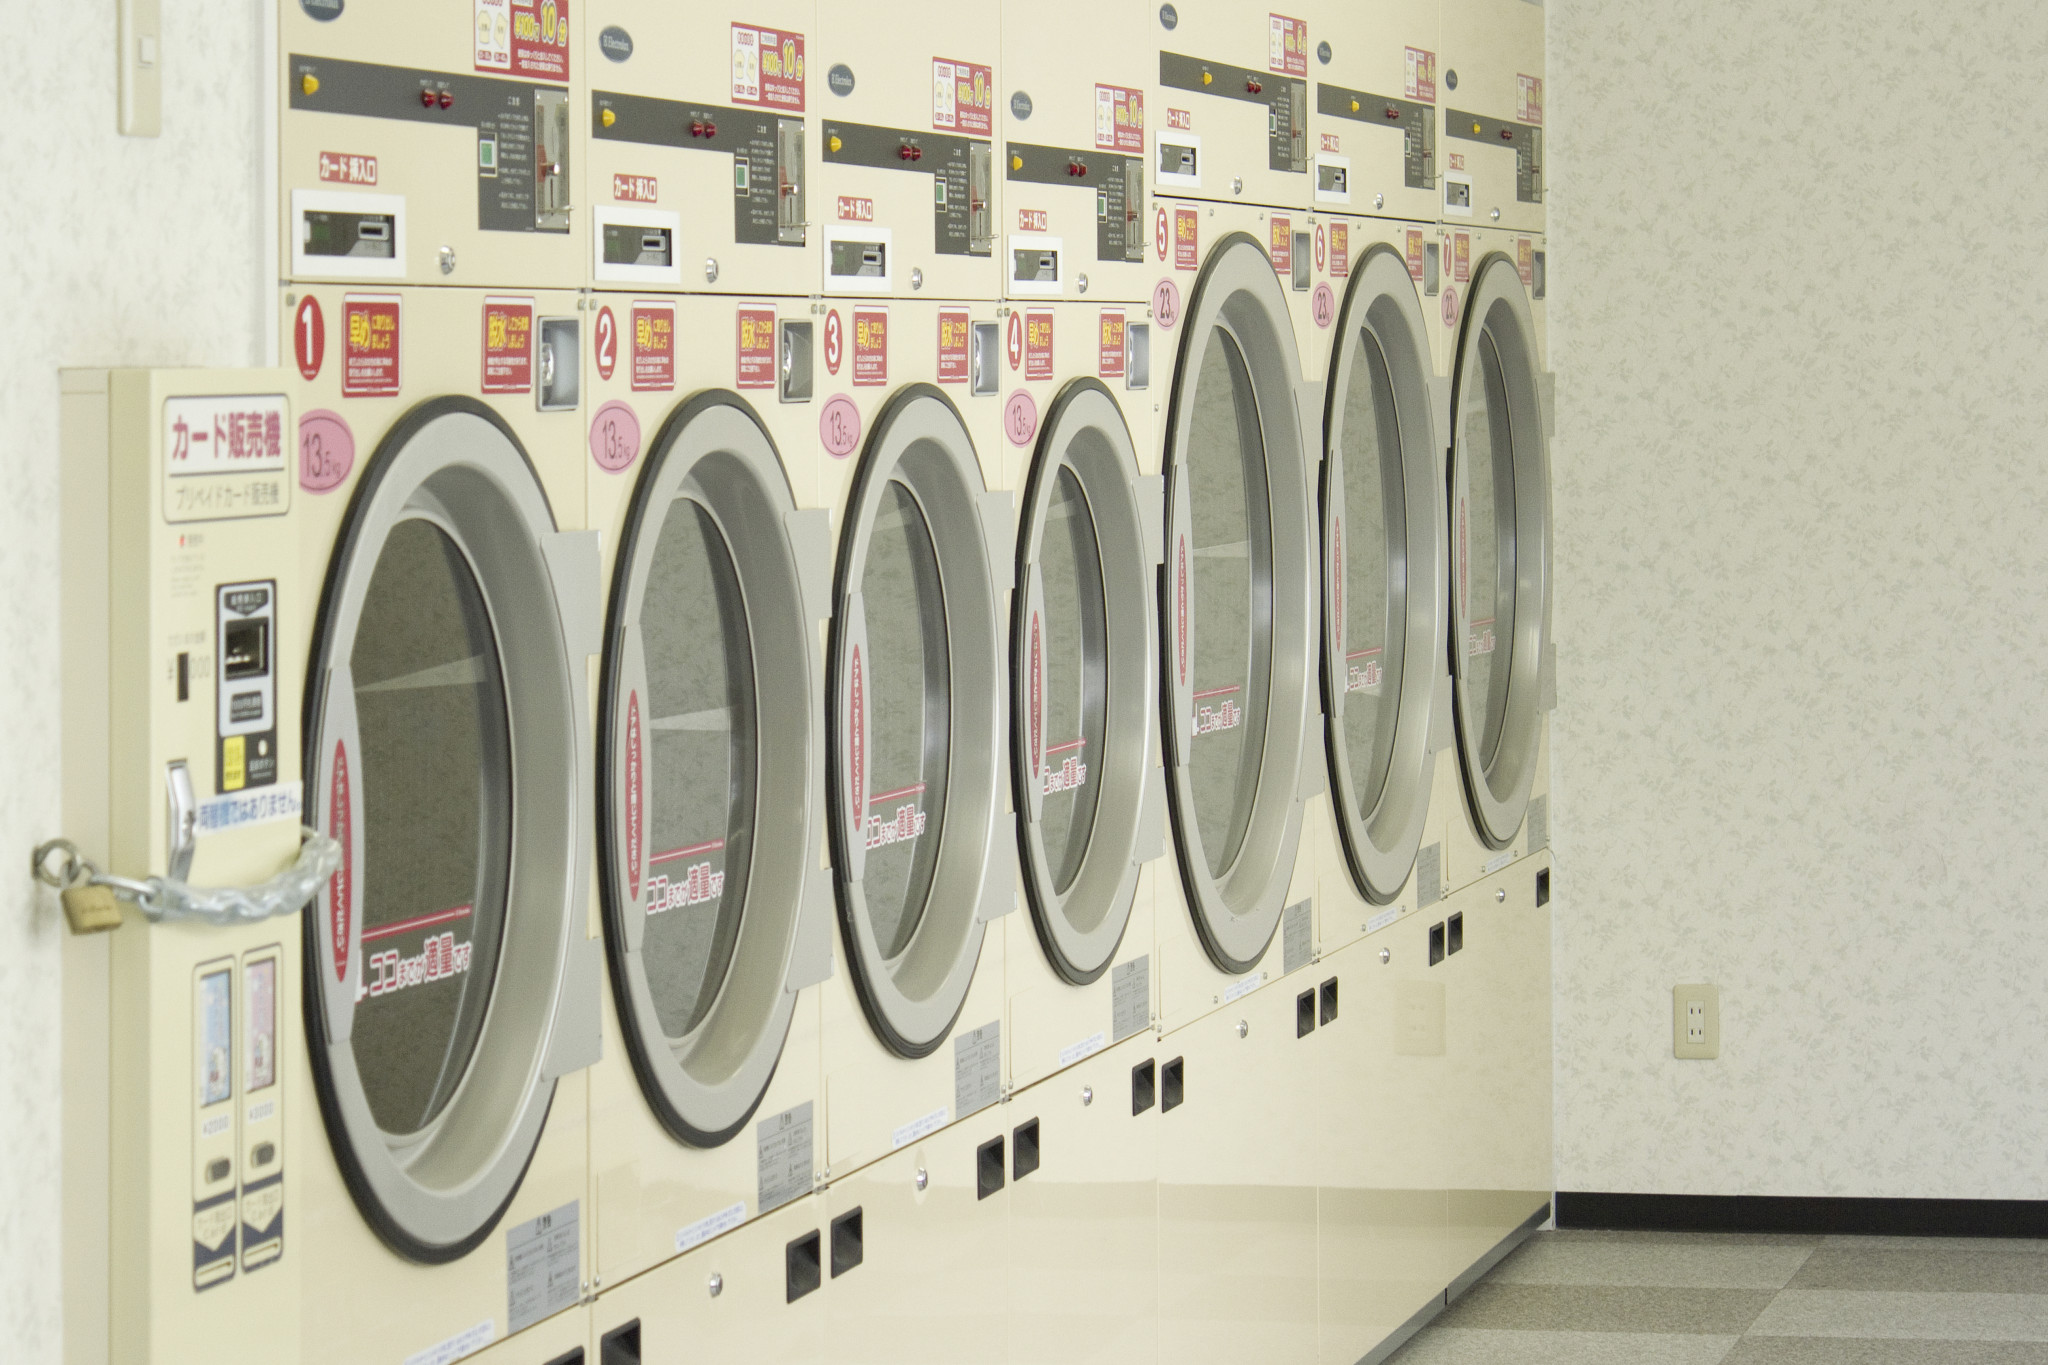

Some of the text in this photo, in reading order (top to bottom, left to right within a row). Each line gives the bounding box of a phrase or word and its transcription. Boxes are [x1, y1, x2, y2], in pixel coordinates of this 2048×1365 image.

[1158, 213, 1166, 252] 5
[1317, 226, 1323, 263] 6
[1445, 238, 1450, 269] 7
[302, 304, 313, 365] 1
[600, 313, 612, 367] 2
[828, 315, 839, 364] 3
[1010, 318, 1019, 360] 4
[172, 411, 281, 460] カード販売機
[647, 862, 725, 915] ココまでが適量です
[370, 931, 472, 997] ココまでが適量です
